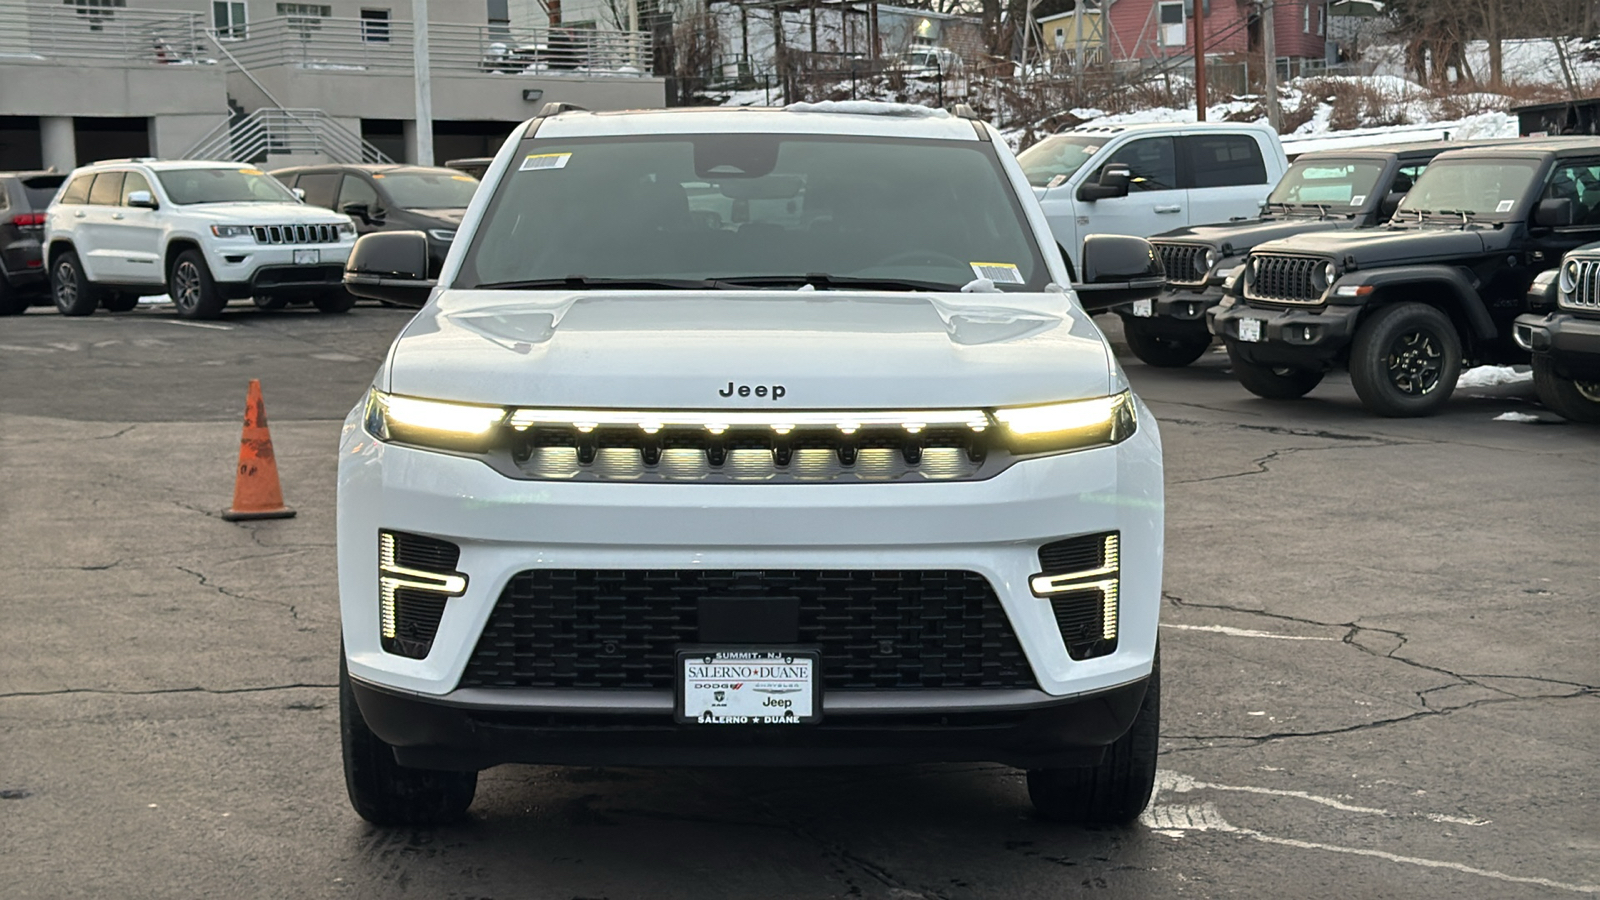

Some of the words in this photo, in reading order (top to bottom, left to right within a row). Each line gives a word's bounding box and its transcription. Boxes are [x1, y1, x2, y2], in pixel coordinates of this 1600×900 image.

[718, 382, 786, 401] Jeep
[767, 652, 782, 660] NJ
[688, 666, 752, 679] SALERNO
[760, 666, 808, 679] DUANE
[762, 697, 792, 709] Jeep
[697, 716, 748, 724] SALERNO
[764, 716, 800, 724] DUANE
